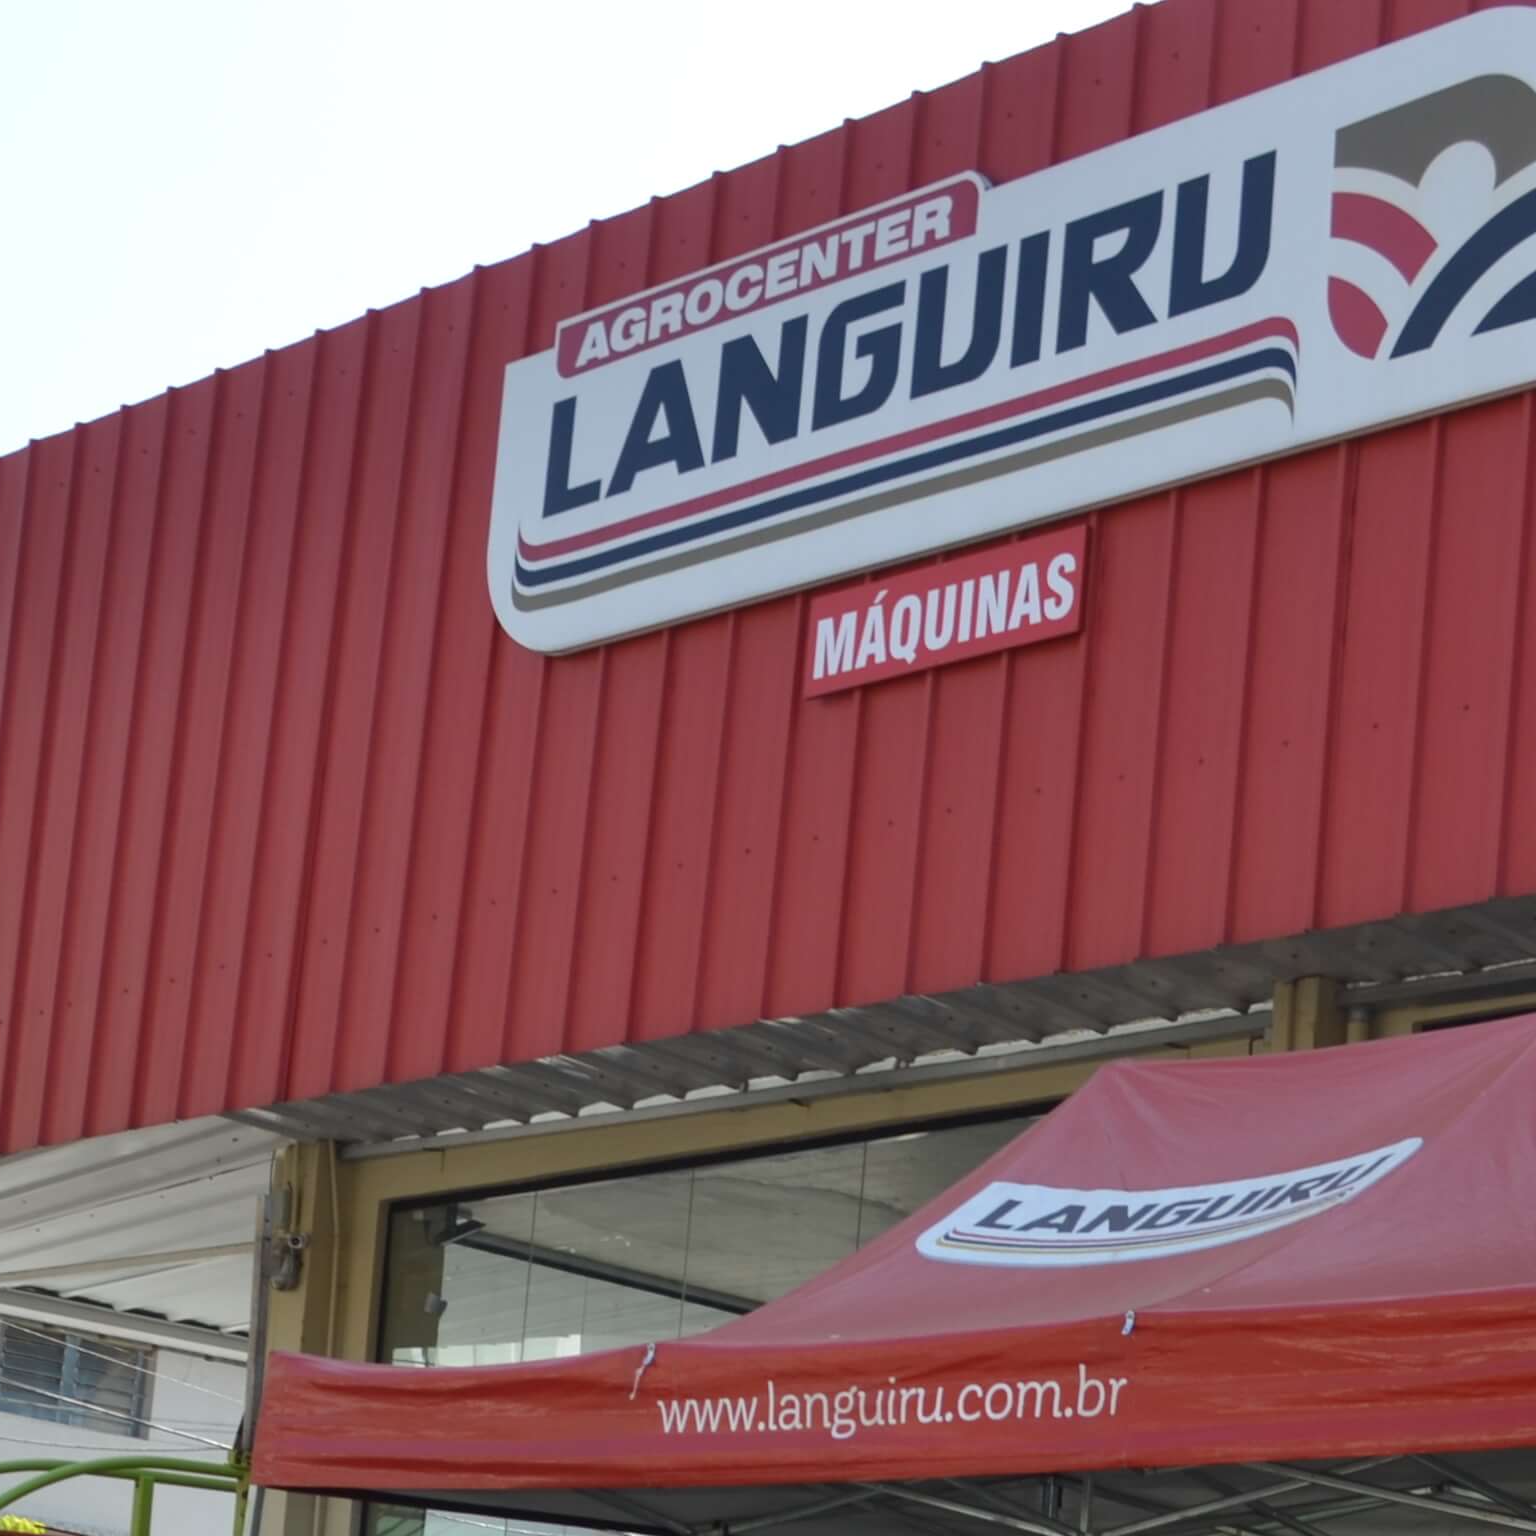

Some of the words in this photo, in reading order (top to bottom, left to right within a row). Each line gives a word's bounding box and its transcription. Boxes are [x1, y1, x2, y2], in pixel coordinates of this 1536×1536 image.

[542, 148, 1277, 518] LANGUIRU
[574, 191, 956, 368] AGROCENTER
[810, 552, 1077, 682] MÁQUINAS
[973, 1154, 1394, 1234] LANGUIRU
[656, 1362, 1129, 1440] www.languiru.com.br
